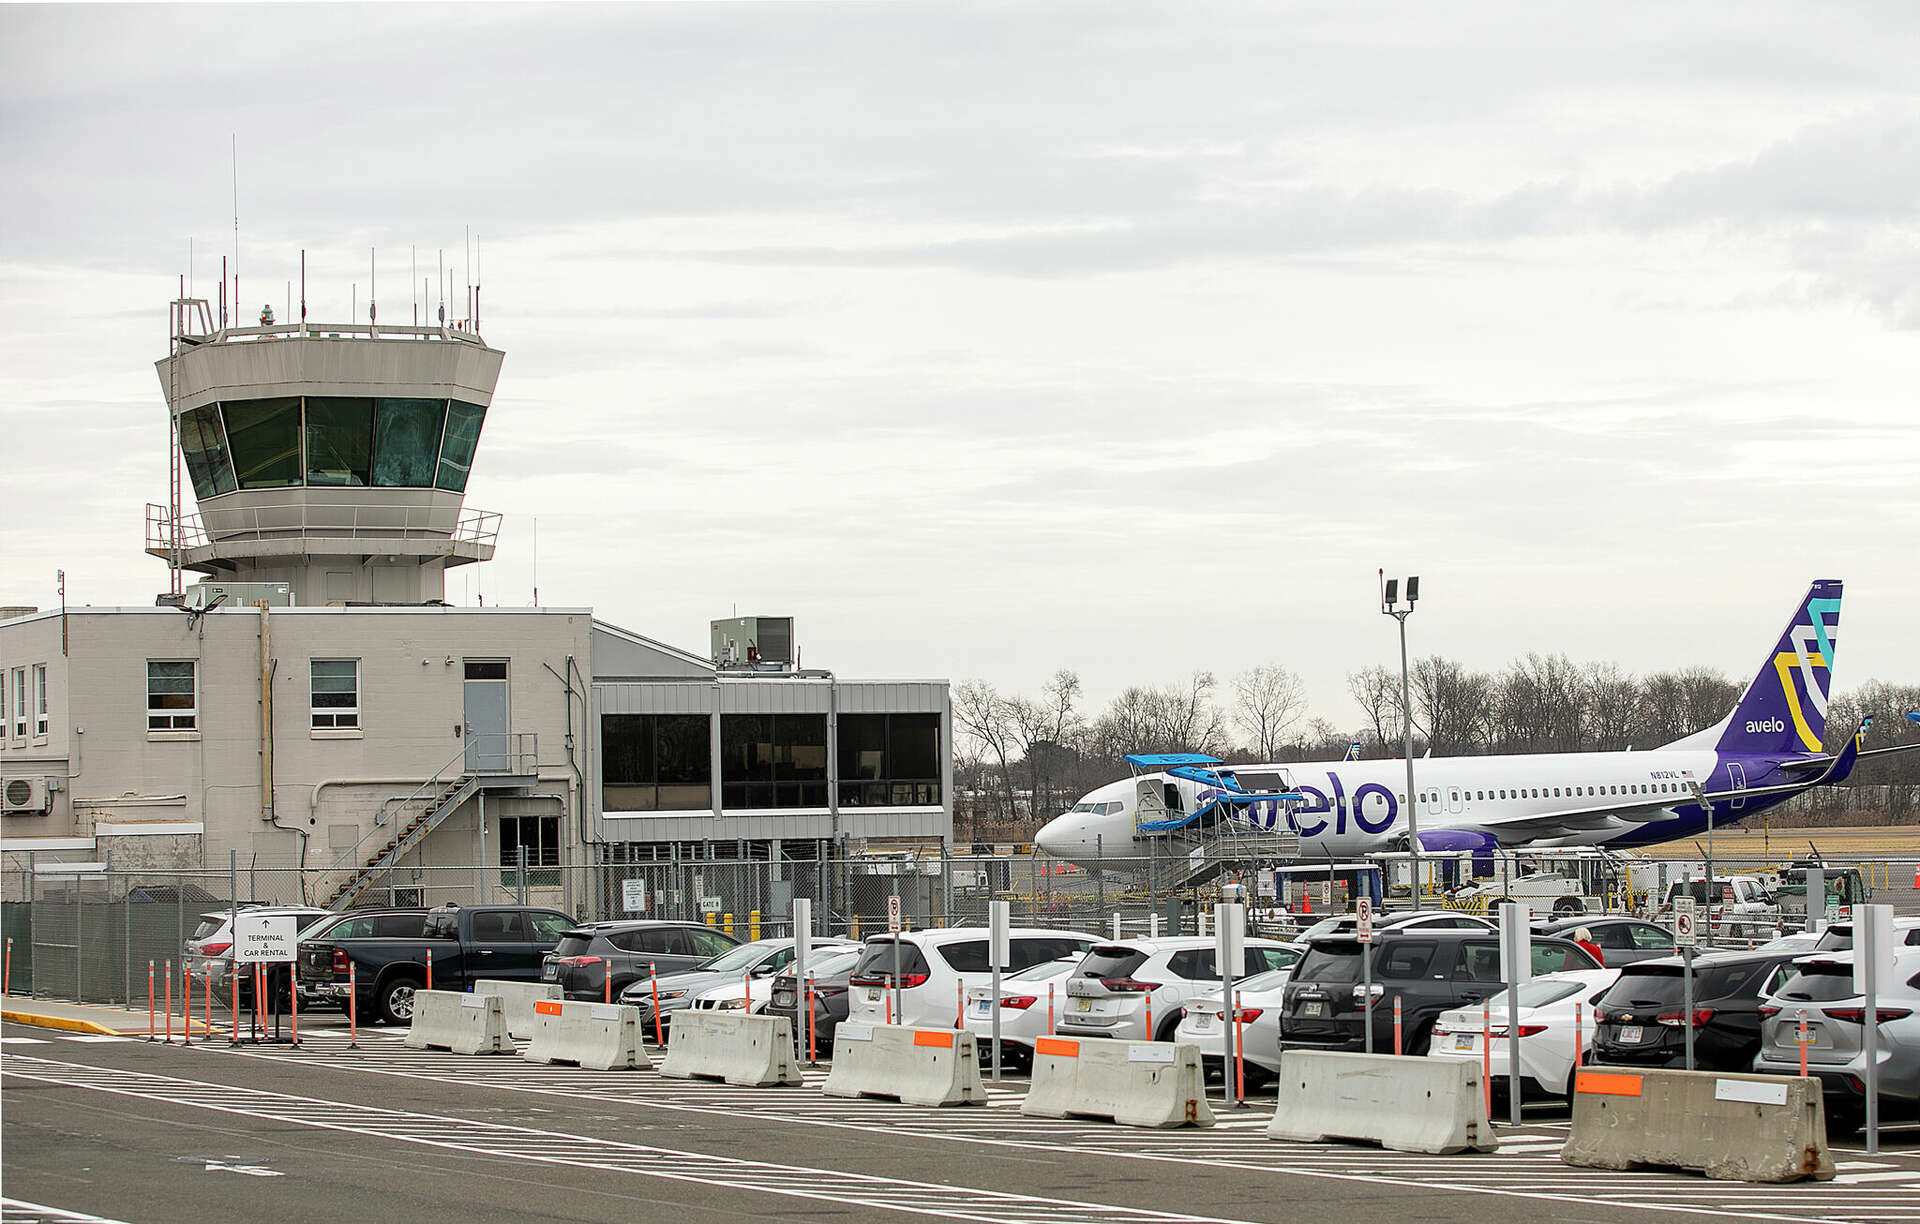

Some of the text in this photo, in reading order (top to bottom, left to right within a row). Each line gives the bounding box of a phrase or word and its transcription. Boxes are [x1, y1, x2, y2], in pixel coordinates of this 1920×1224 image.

[1745, 716, 1785, 733] avelo
[1650, 770, 1680, 779] N812VL
[248, 934, 284, 942] TERMINAL
[244, 949, 259, 957] CAR
